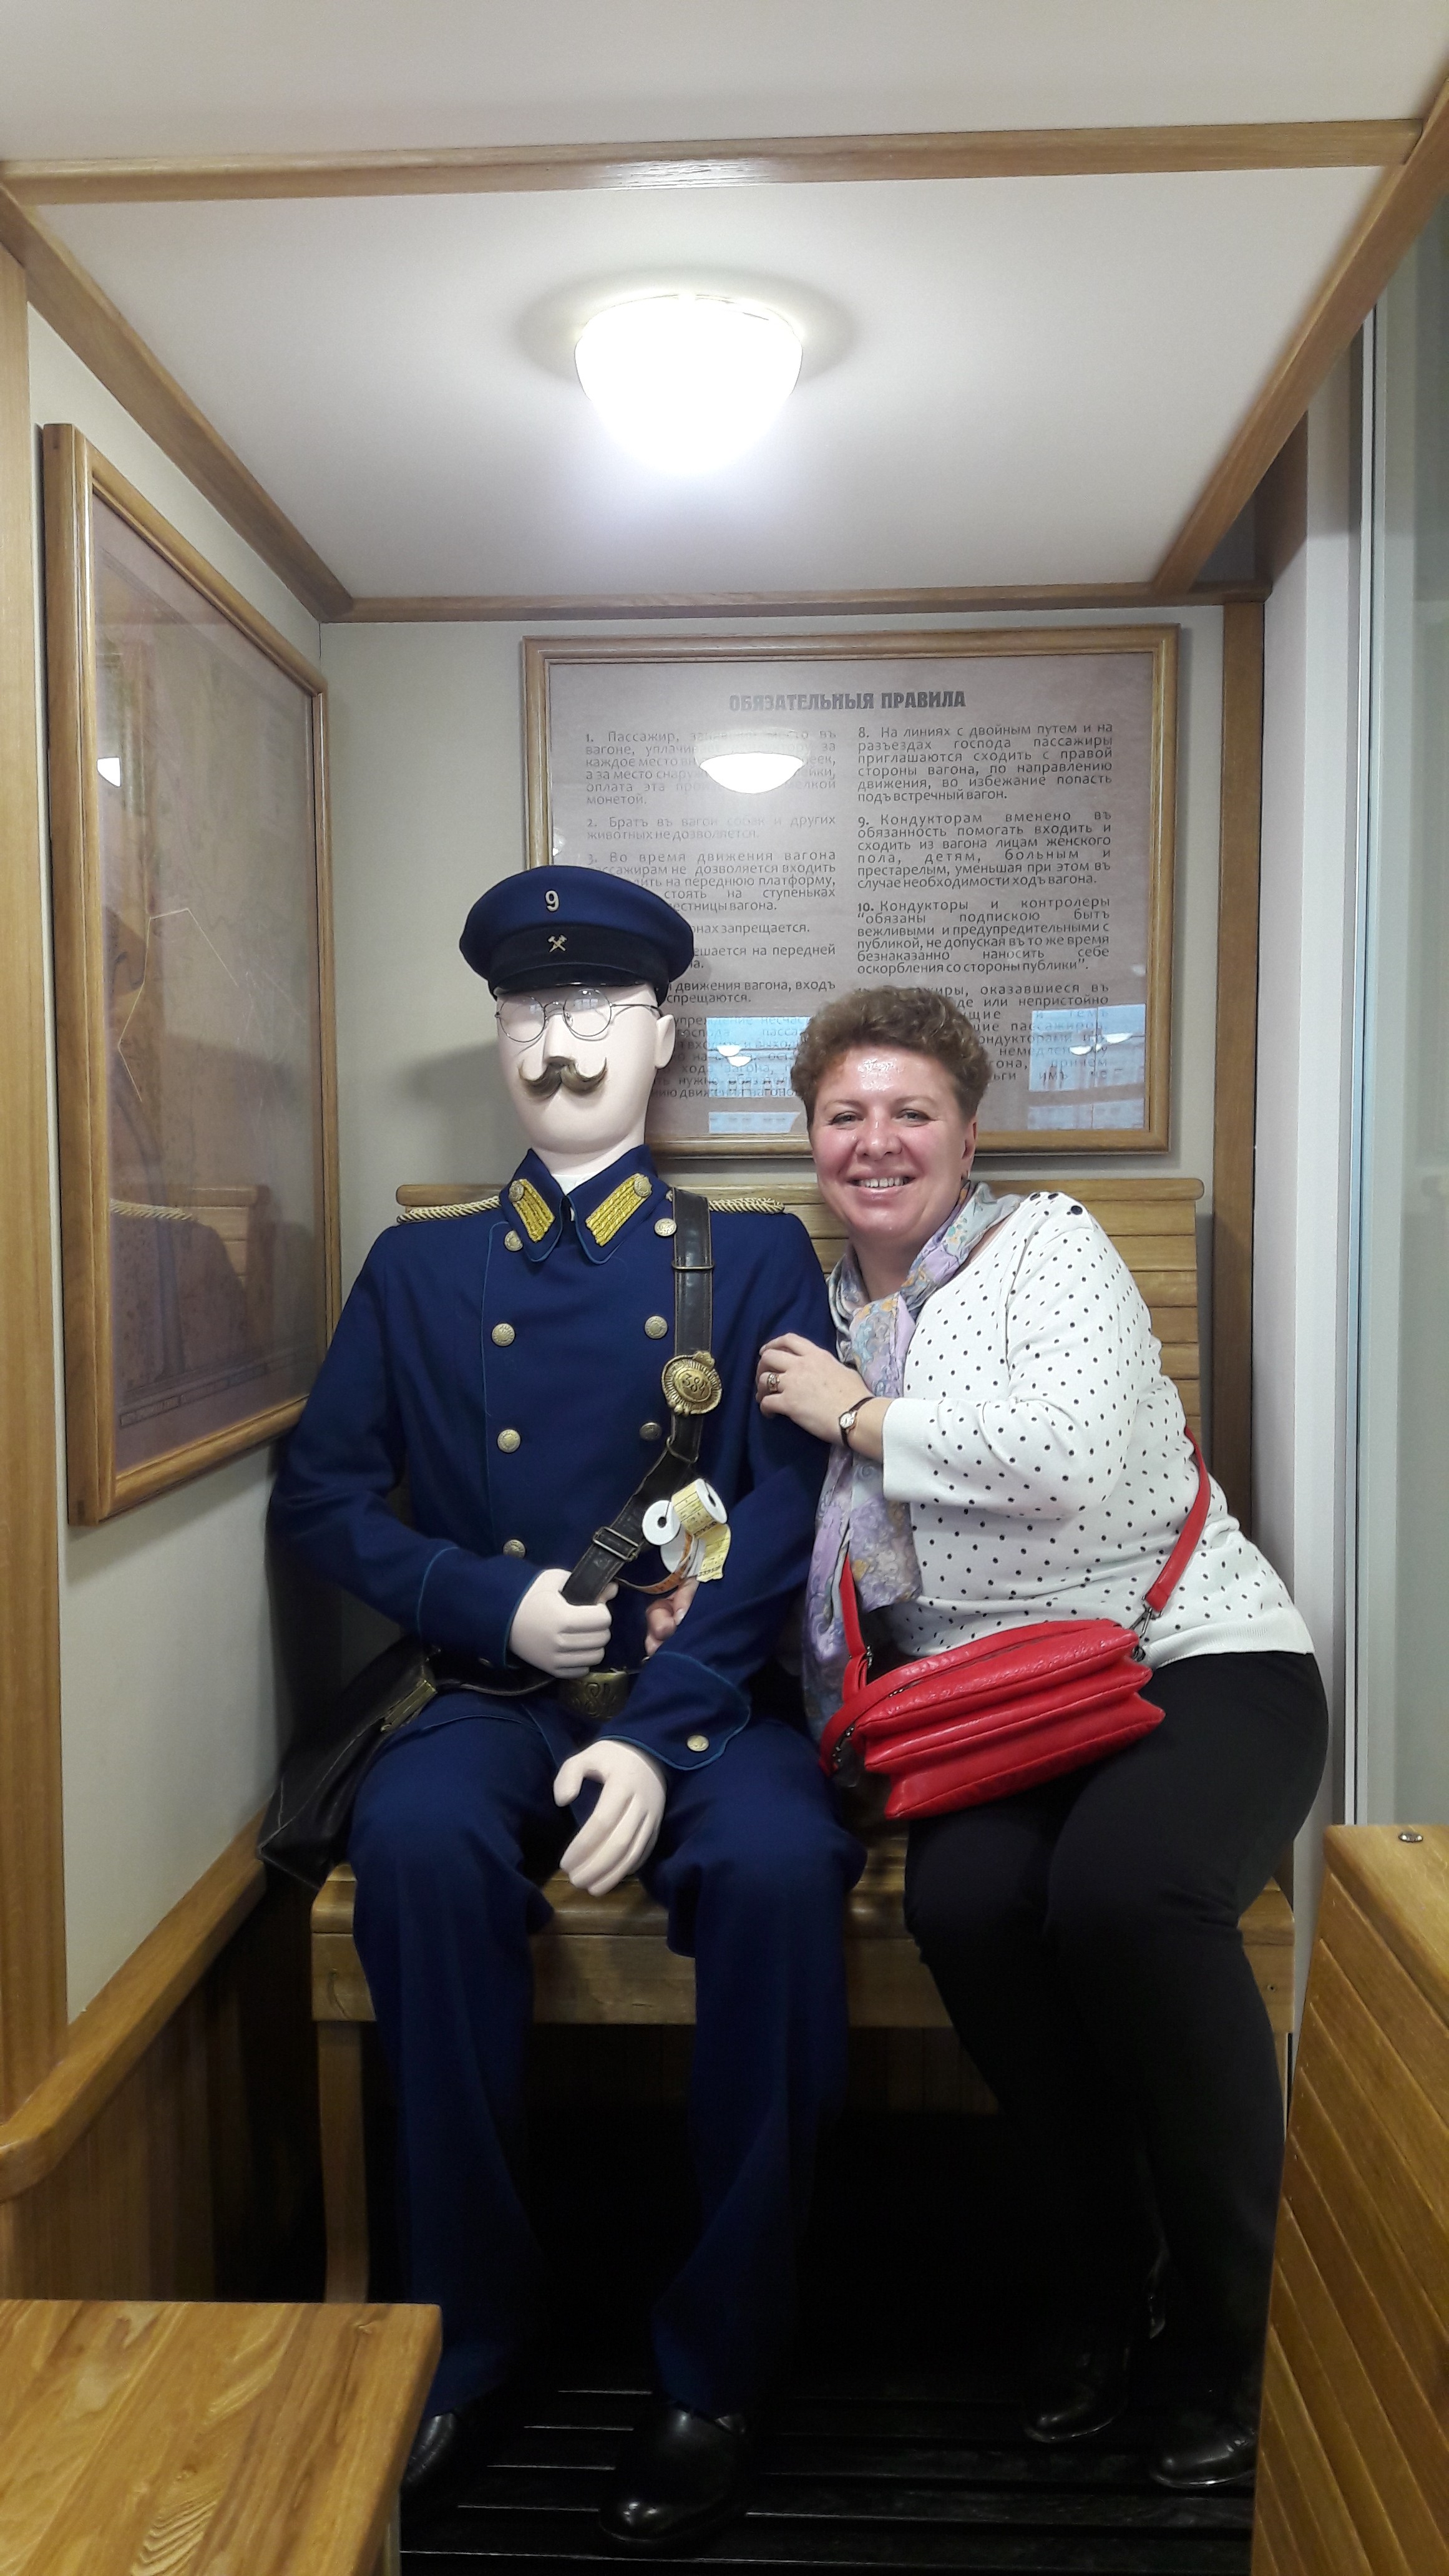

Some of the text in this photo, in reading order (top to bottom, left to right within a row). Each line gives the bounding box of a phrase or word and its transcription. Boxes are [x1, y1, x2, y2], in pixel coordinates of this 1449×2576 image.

[881, 691, 966, 708] ПРАВИЛА
[586, 734, 593, 742] 1.
[608, 731, 679, 744] Пассажир,
[859, 724, 1112, 738] 8. На линиях с двойным путем и на
[586, 743, 835, 755] вагоне, за
[859, 738, 1111, 754] разъездах господа пассажиры
[587, 758, 634, 769] каждое
[639, 758, 677, 766] место
[859, 747, 1111, 768] приглашаются сходить с правой
[587, 771, 592, 779] а
[597, 771, 609, 779] за
[614, 771, 652, 779] место
[859, 763, 1111, 779] стороны вагона, по направлению
[587, 783, 632, 793] оплата
[858, 779, 930, 792] движения,
[943, 779, 957, 787] во
[970, 774, 1045, 786] избежание
[587, 794, 646, 804] монетой.
[859, 789, 1007, 804] подъ встречный вагон.
[587, 819, 597, 827] 2.
[790, 817, 835, 828] других
[858, 812, 1111, 827] 9. Кондукторам вменено въ
[587, 831, 652, 839] животных
[858, 827, 946, 837] обязанность
[958, 826, 1023, 836] помогать
[1035, 825, 1091, 837] входить
[858, 837, 1110, 852] сходить из вагона лицам женского
[610, 852, 627, 862] Во
[646, 852, 685, 866] время
[698, 853, 772, 864] движения
[785, 852, 835, 861] вагона
[859, 855, 900, 865] пола,
[925, 854, 980, 864] детям,
[1005, 849, 1078, 860] больным
[672, 866, 686, 874] не
[695, 866, 778, 877] дозволяется
[858, 862, 1110, 879] престарелым, уменьшая при этом въ
[685, 878, 754, 889] переднюю
[759, 874, 835, 888] платформу,
[858, 876, 1096, 891] случае необходимости ходъ вагона.
[545, 890, 560, 912] 9
[665, 889, 835, 900] стоять на ступеньках
[671, 902, 776, 913] естницы вагона.
[858, 899, 1109, 914] 10. Кондукторы и контролеры
[960, 912, 1040, 924] подпискою
[1075, 909, 1110, 920] бытъ
[721, 924, 809, 936] запрещается.
[858, 927, 934, 936] вежливыми
[954, 924, 1099, 938] предупредительными
[858, 938, 922, 952] публикой,
[944, 939, 1005, 950] допуская
[1010, 938, 1024, 946] въ
[1068, 936, 1108, 947] время
[773, 947, 835, 958] передней
[858, 948, 1109, 961] безнаказанно наносить себе
[858, 962, 943, 977] оскорбления
[947, 964, 960, 972] со
[964, 964, 1020, 975] стороны
[676, 982, 740, 993] движения
[745, 982, 791, 992] вагона,
[981, 984, 1108, 995] оказавшиеся въ
[667, 993, 751, 1004] спрещаются.
[1019, 995, 1110, 1010] непристойно
